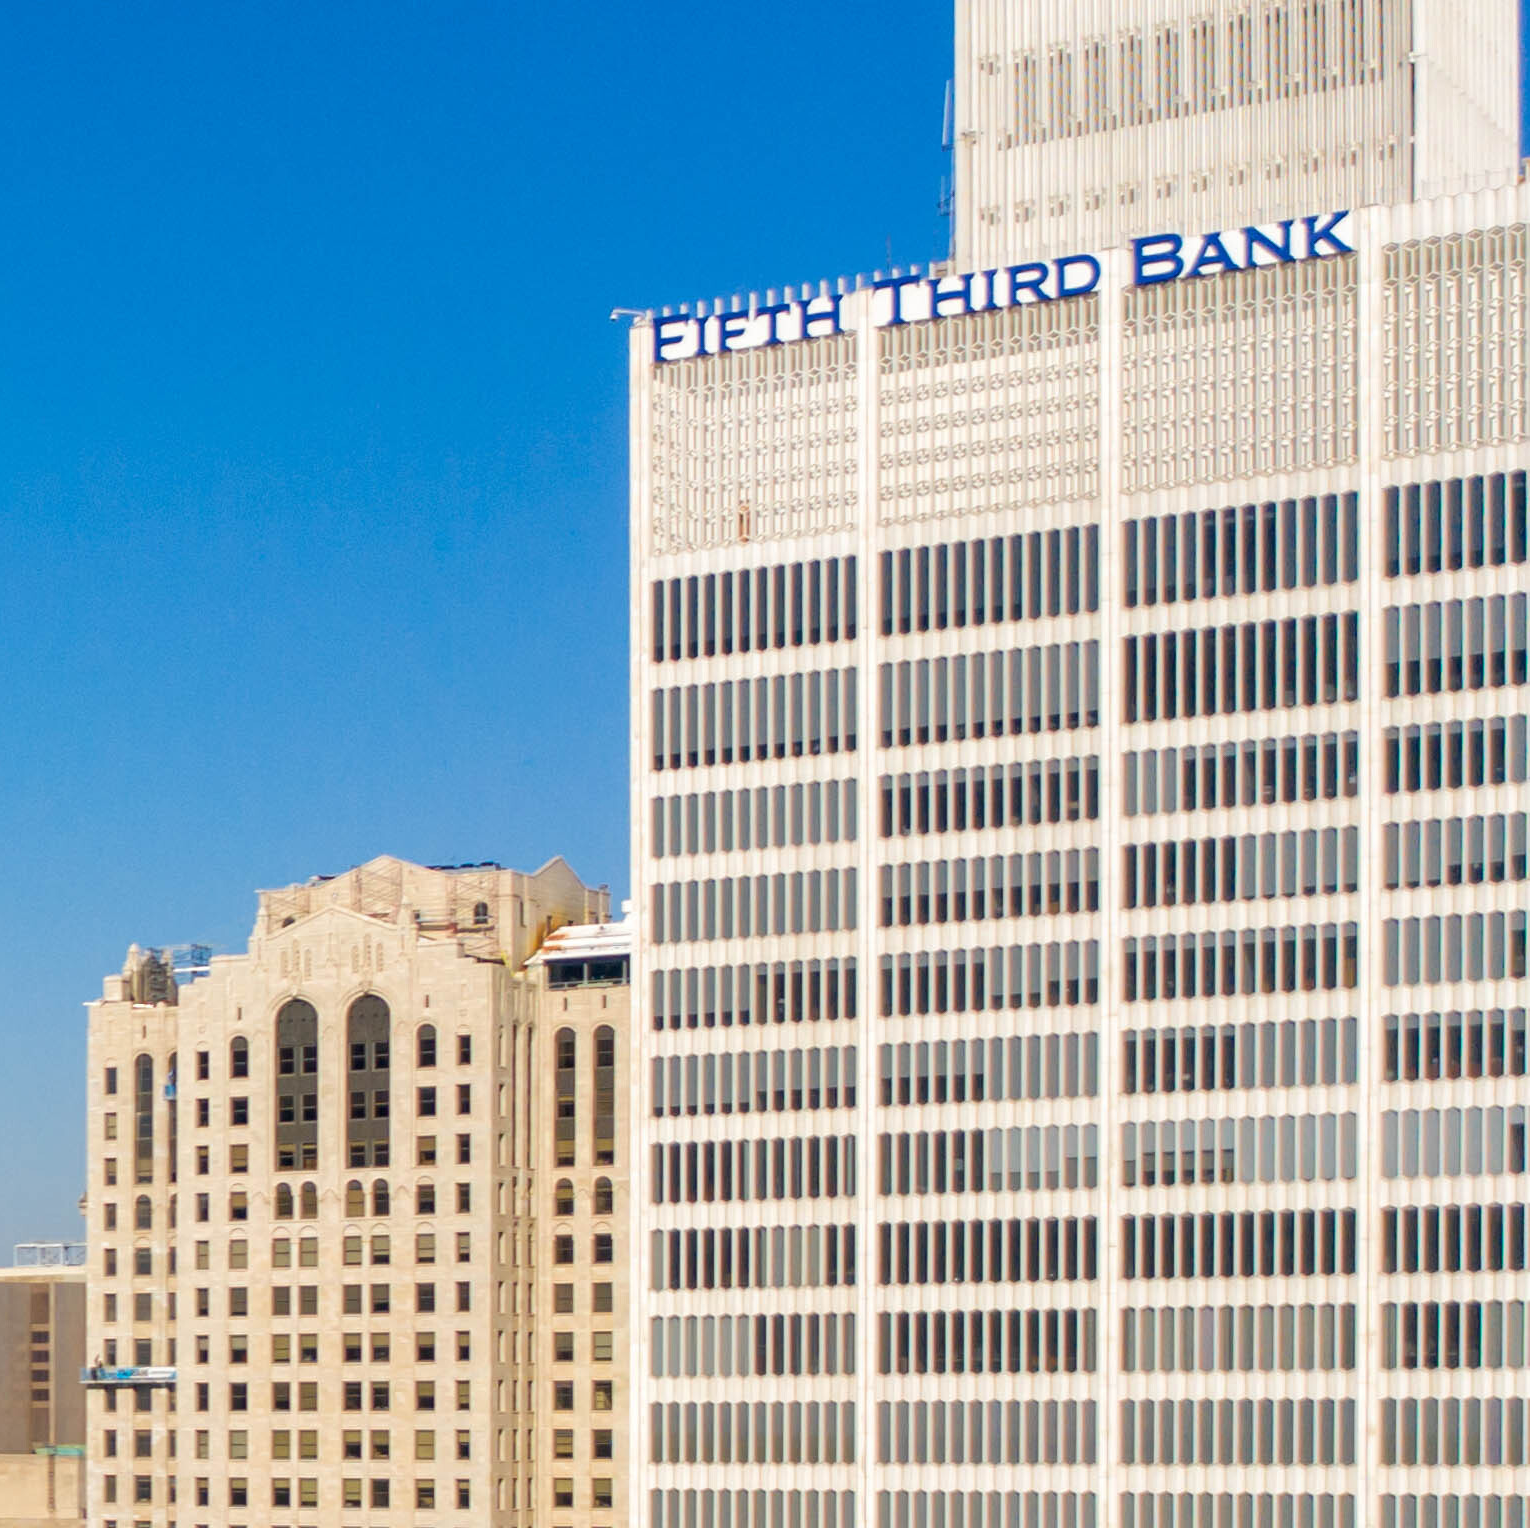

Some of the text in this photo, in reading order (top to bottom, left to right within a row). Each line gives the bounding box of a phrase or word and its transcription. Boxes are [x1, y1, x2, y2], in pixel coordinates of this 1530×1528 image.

[654, 210, 1354, 363] FIFTH THIRD BANK
